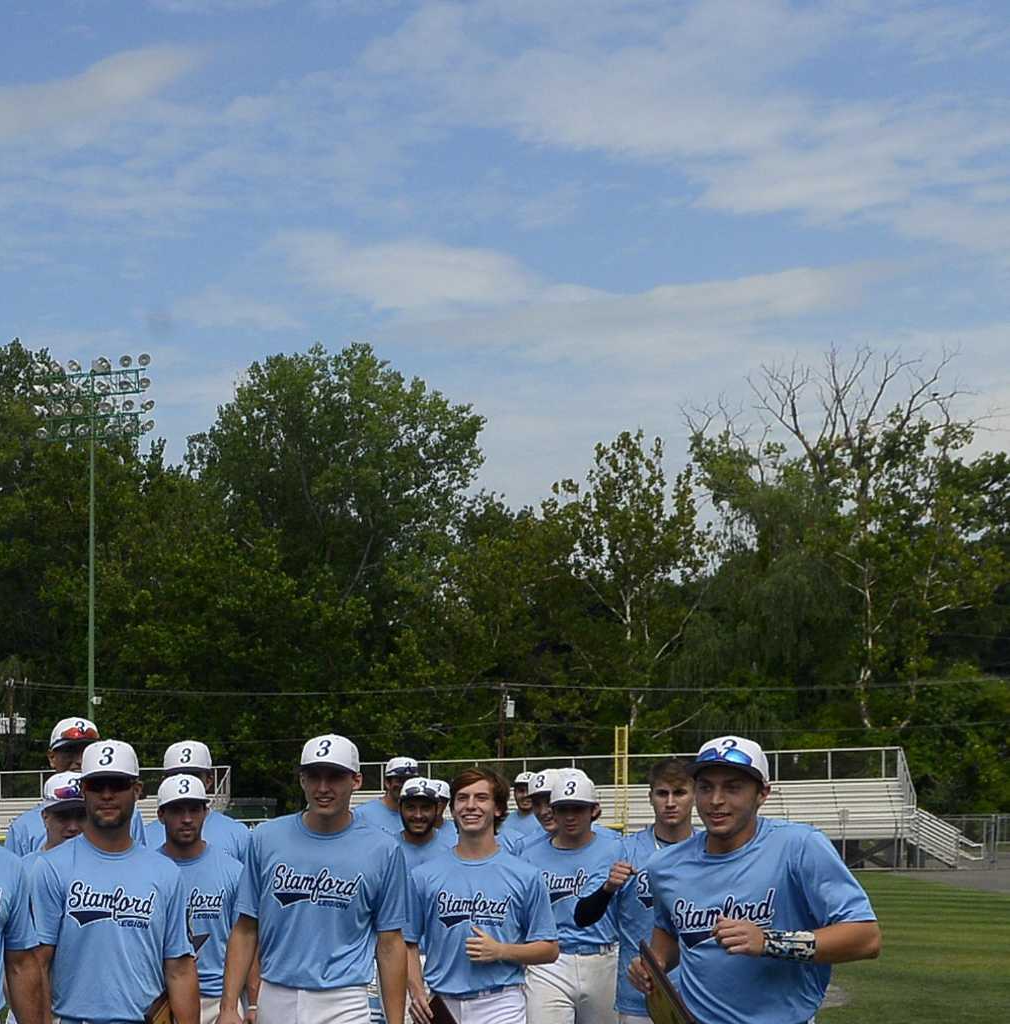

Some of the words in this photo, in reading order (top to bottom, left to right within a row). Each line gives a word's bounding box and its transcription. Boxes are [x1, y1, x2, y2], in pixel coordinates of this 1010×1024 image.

[98, 746, 115, 767] 3
[180, 747, 193, 764] 3
[316, 739, 332, 758] 3
[178, 778, 190, 795] 3
[535, 774, 546, 789] 3
[563, 780, 577, 797] 3
[273, 863, 362, 904] Stamford
[68, 880, 155, 921] Stamford
[189, 887, 225, 909] ford
[437, 890, 512, 922] Stamford
